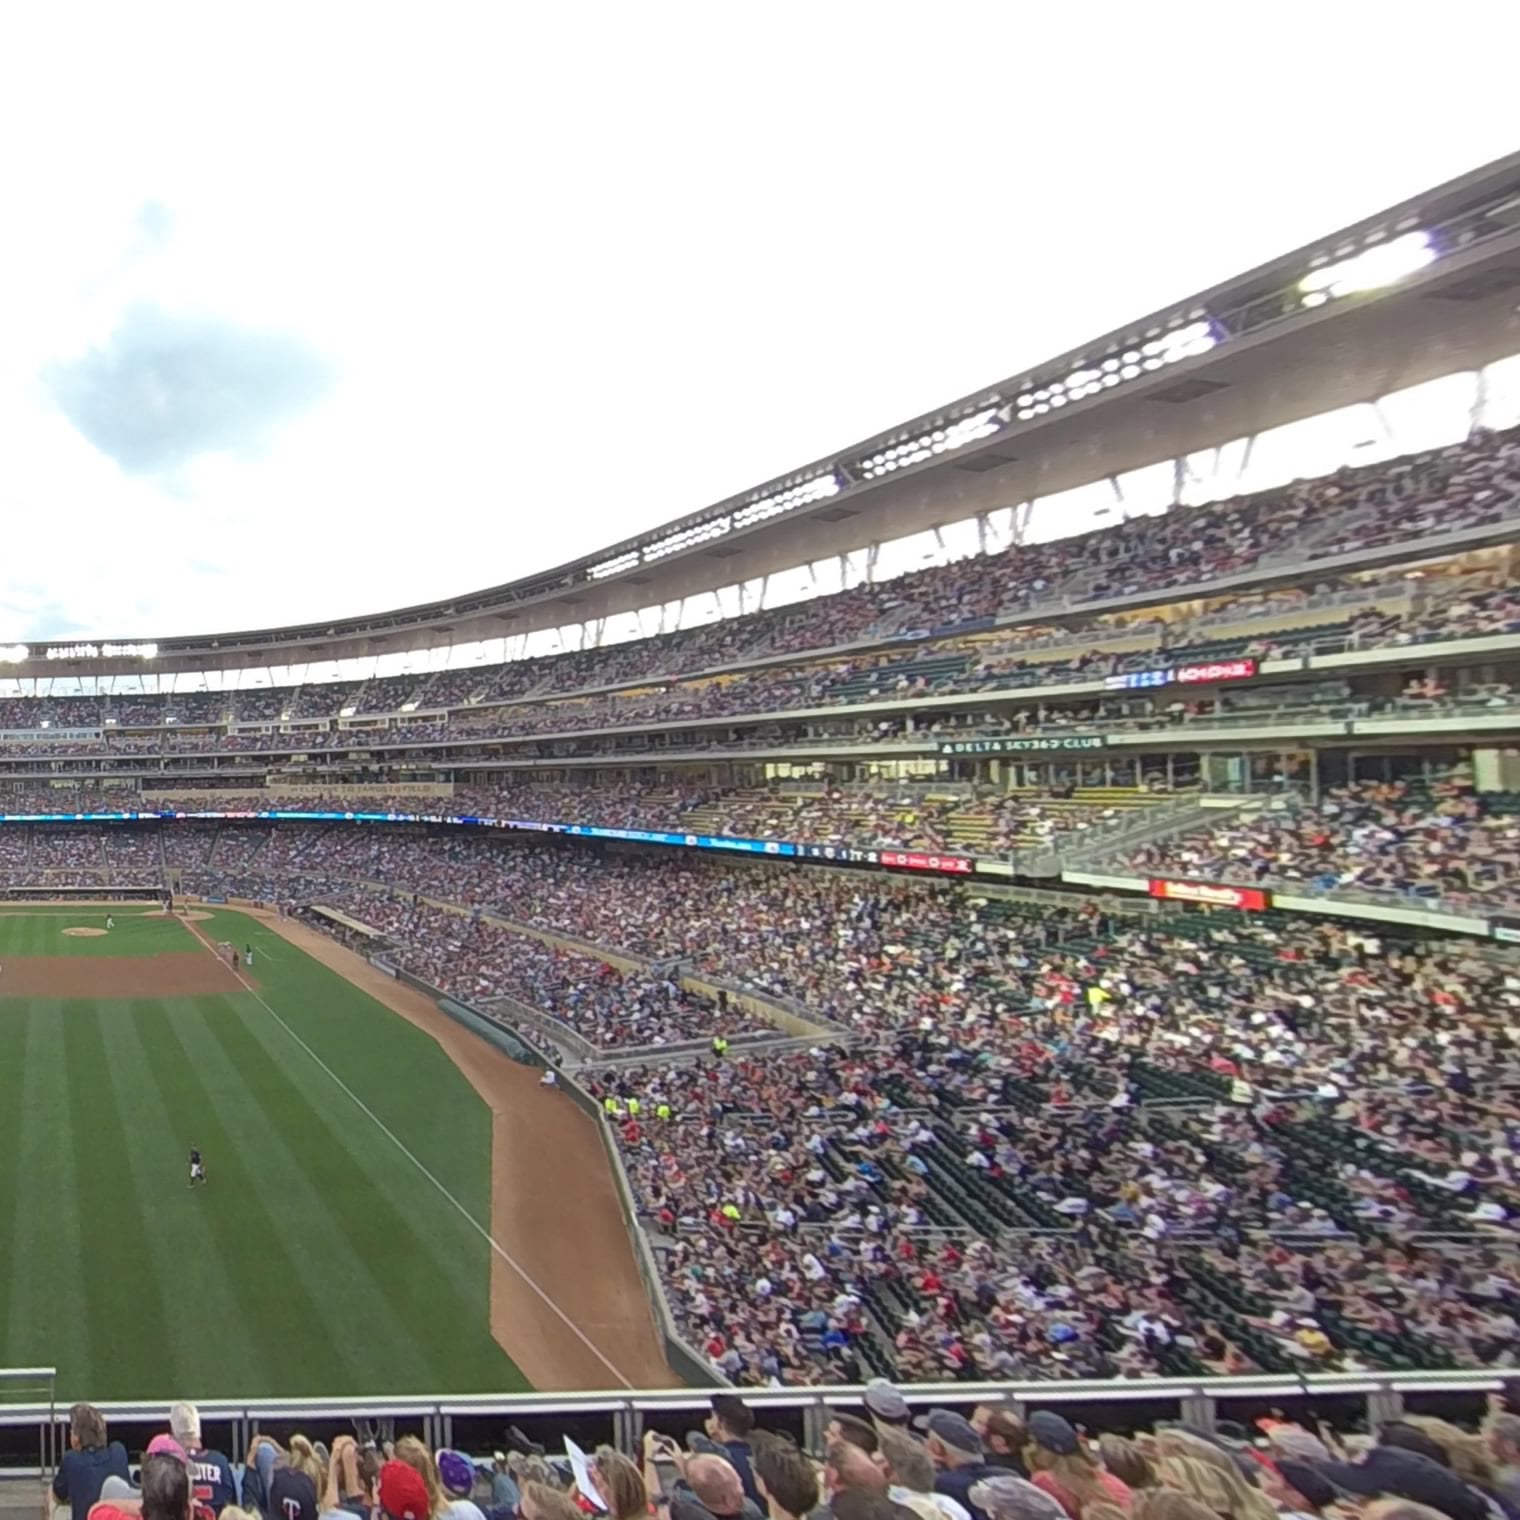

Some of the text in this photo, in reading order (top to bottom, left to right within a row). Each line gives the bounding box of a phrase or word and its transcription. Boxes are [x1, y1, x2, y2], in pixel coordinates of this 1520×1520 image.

[954, 742, 1001, 753] DELTA
[1063, 737, 1103, 748] CLUB
[402, 785, 431, 793] FIELD
